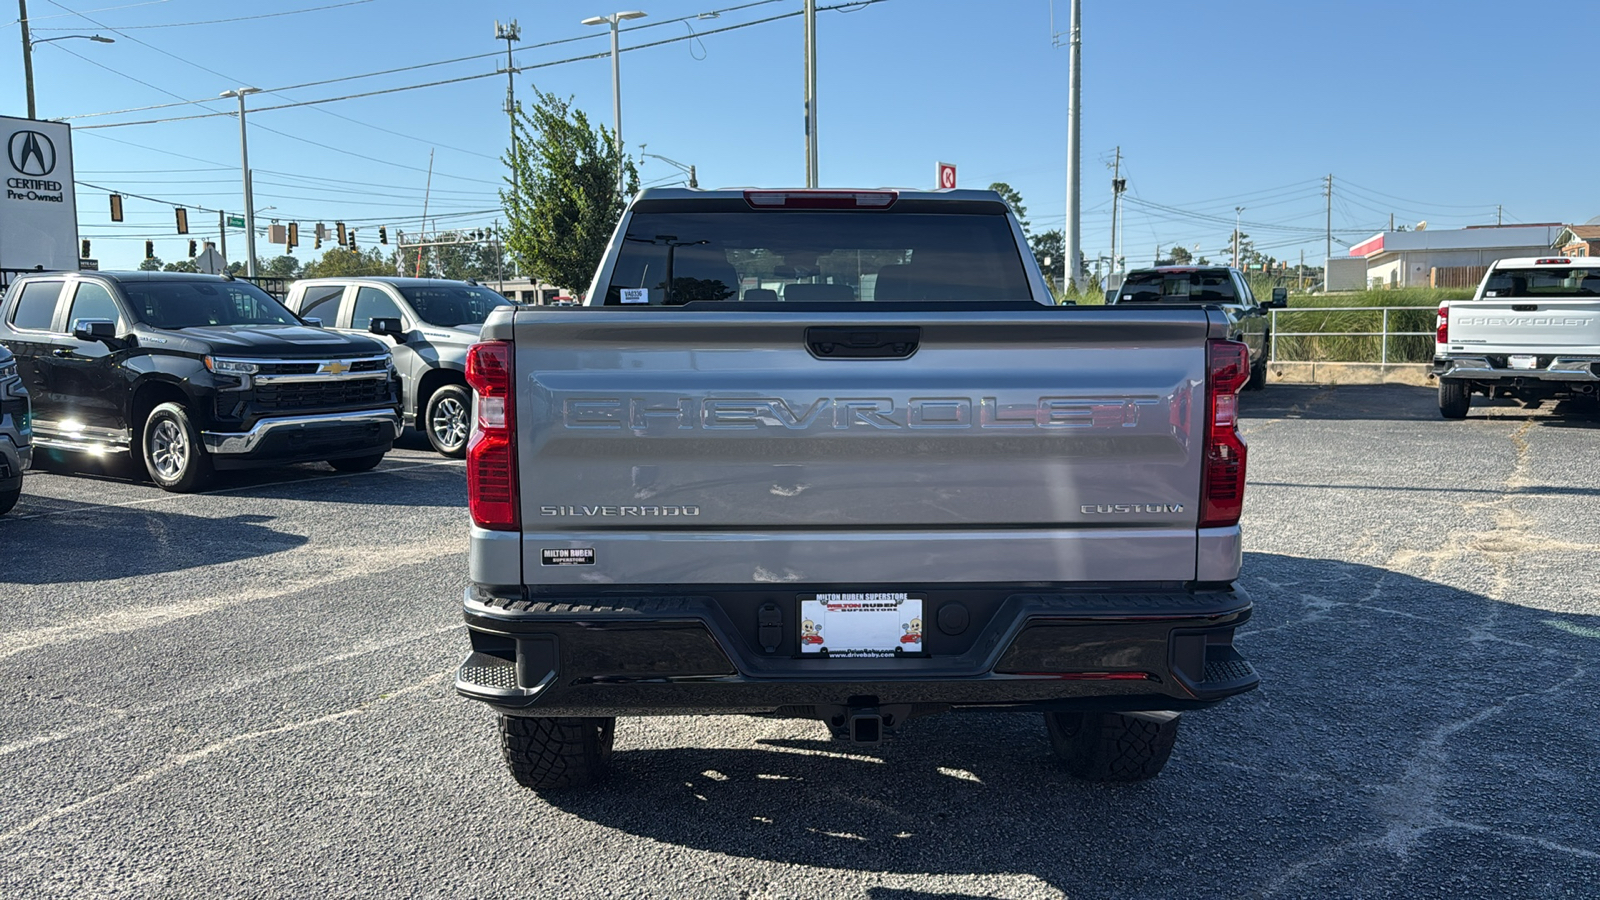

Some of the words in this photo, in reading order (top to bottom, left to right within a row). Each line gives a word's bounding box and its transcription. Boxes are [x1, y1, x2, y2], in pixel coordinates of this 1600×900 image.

[7, 178, 62, 191] CERTIFIED
[7, 190, 63, 202] Pre-Owned
[1458, 318, 1594, 327] CHEVROLET
[563, 395, 1160, 430] CHEVROLET
[540, 505, 700, 516] SILVERADO
[1081, 503, 1184, 514] CUSTOM
[544, 550, 569, 558] MILTON
[570, 550, 593, 558] RUBEN
